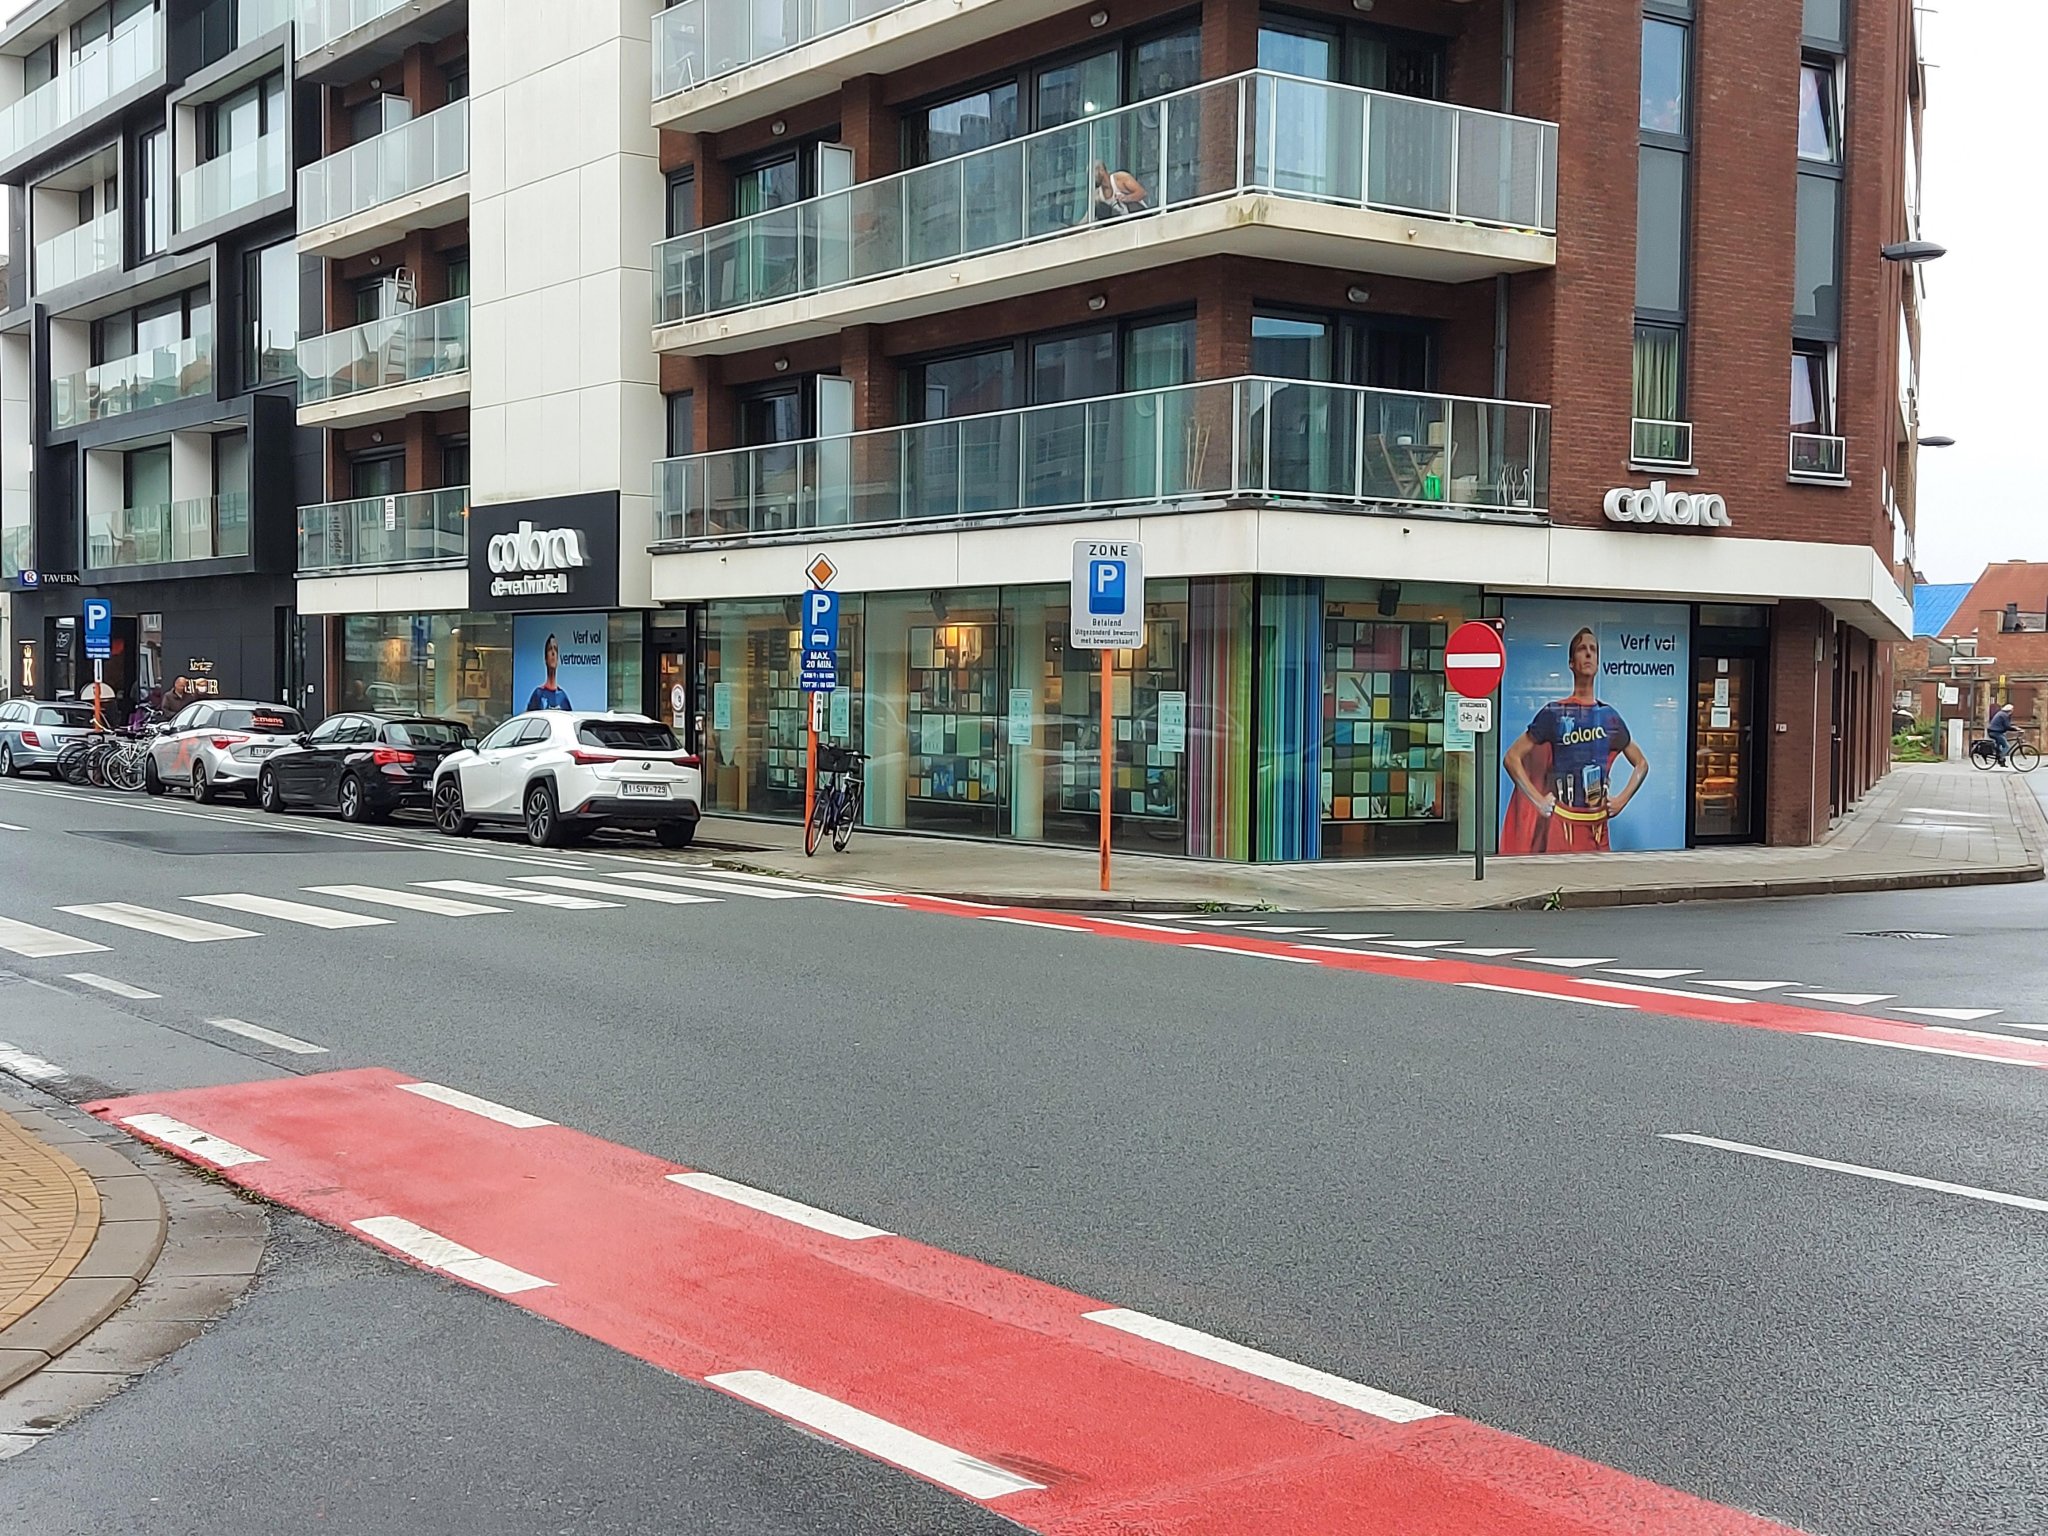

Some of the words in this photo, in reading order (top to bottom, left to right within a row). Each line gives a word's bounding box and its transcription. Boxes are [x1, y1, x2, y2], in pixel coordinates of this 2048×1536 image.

[1603, 481, 1732, 526] colora
[488, 521, 583, 573] colora
[1089, 545, 1128, 556] ZONE
[1097, 564, 1118, 592] P
[88, 605, 106, 630] P
[811, 594, 831, 625] P
[1092, 618, 1122, 626] Betalend
[573, 629, 588, 644] Verf
[590, 629, 601, 644] vol
[1620, 634, 1651, 651] Verf
[1655, 634, 1675, 651] vol
[560, 654, 601, 665] vertrouwen
[810, 651, 830, 660] MAX.
[806, 660, 815, 668] 20
[817, 660, 834, 669] MIN.
[1603, 660, 1675, 676] vertrouwen
